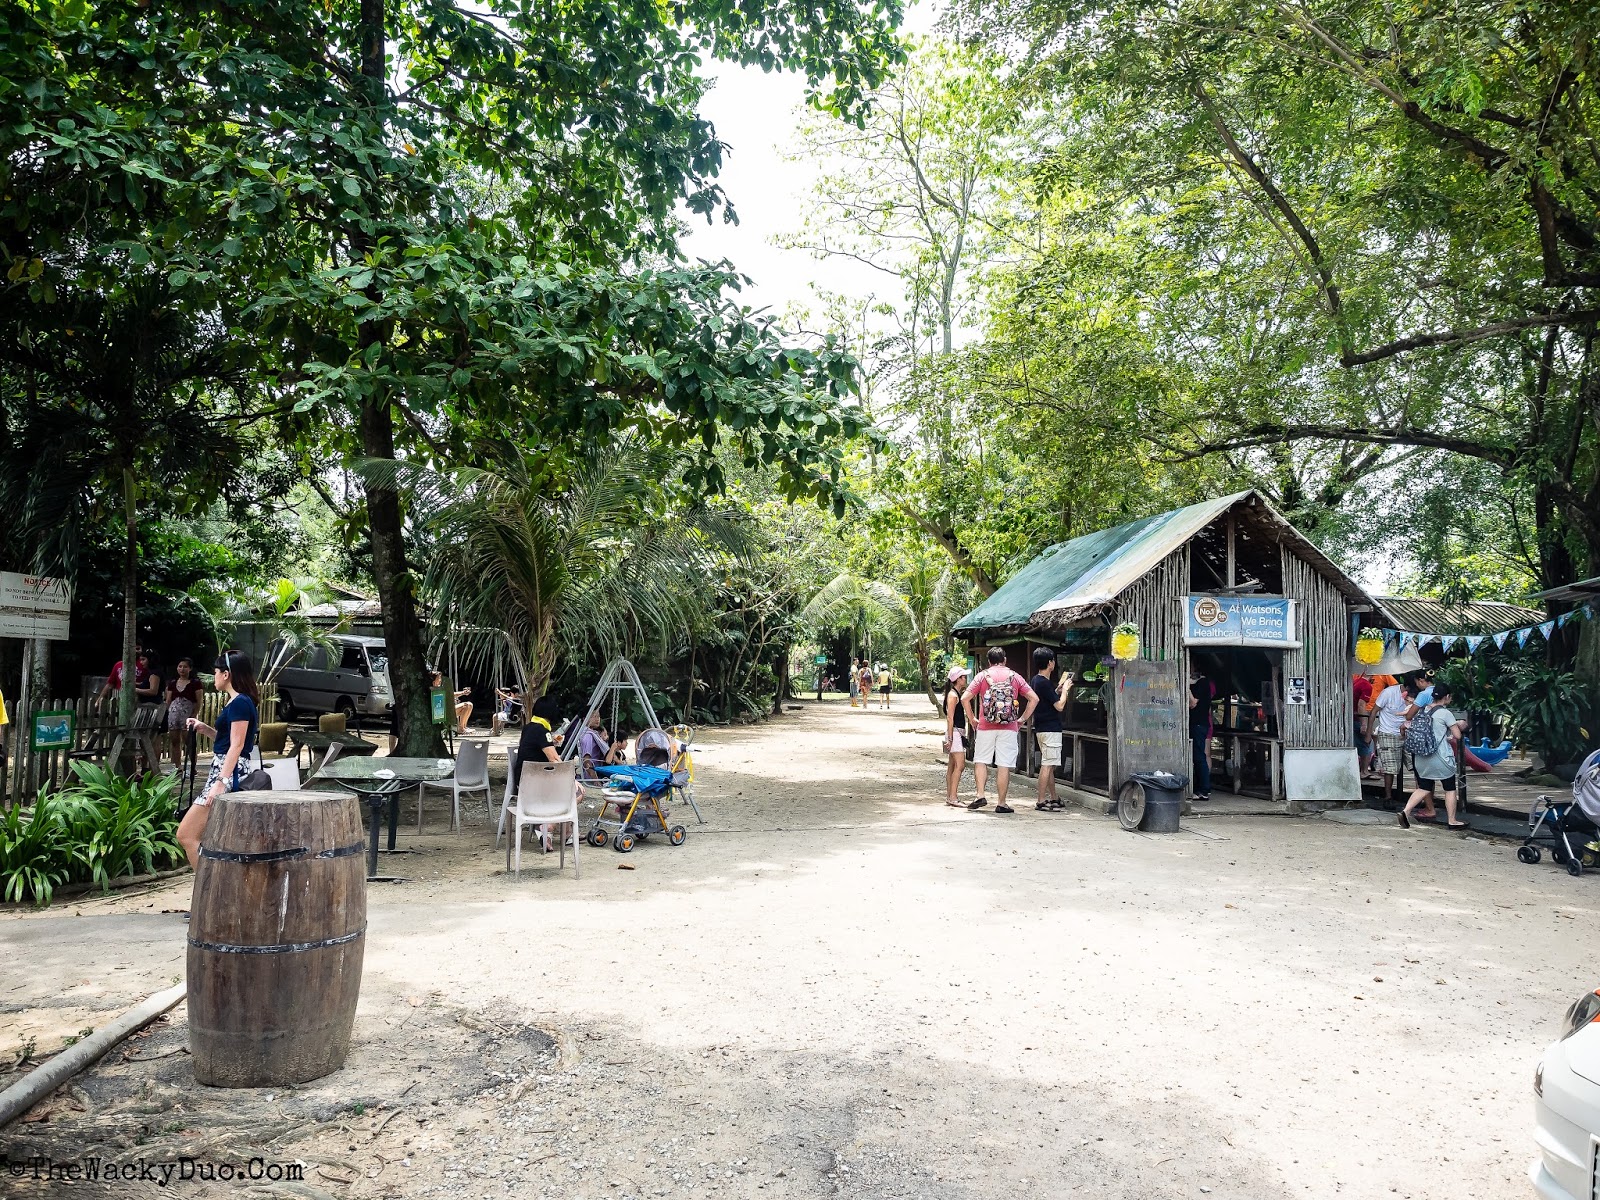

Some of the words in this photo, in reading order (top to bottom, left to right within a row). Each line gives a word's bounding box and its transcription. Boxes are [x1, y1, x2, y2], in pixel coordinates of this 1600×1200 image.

[1229, 604, 1240, 613] At
[1242, 604, 1284, 616] Watsons,
[1241, 617, 1257, 626] We
[1259, 617, 1283, 628] Bring
[1245, 629, 1283, 639] Services
